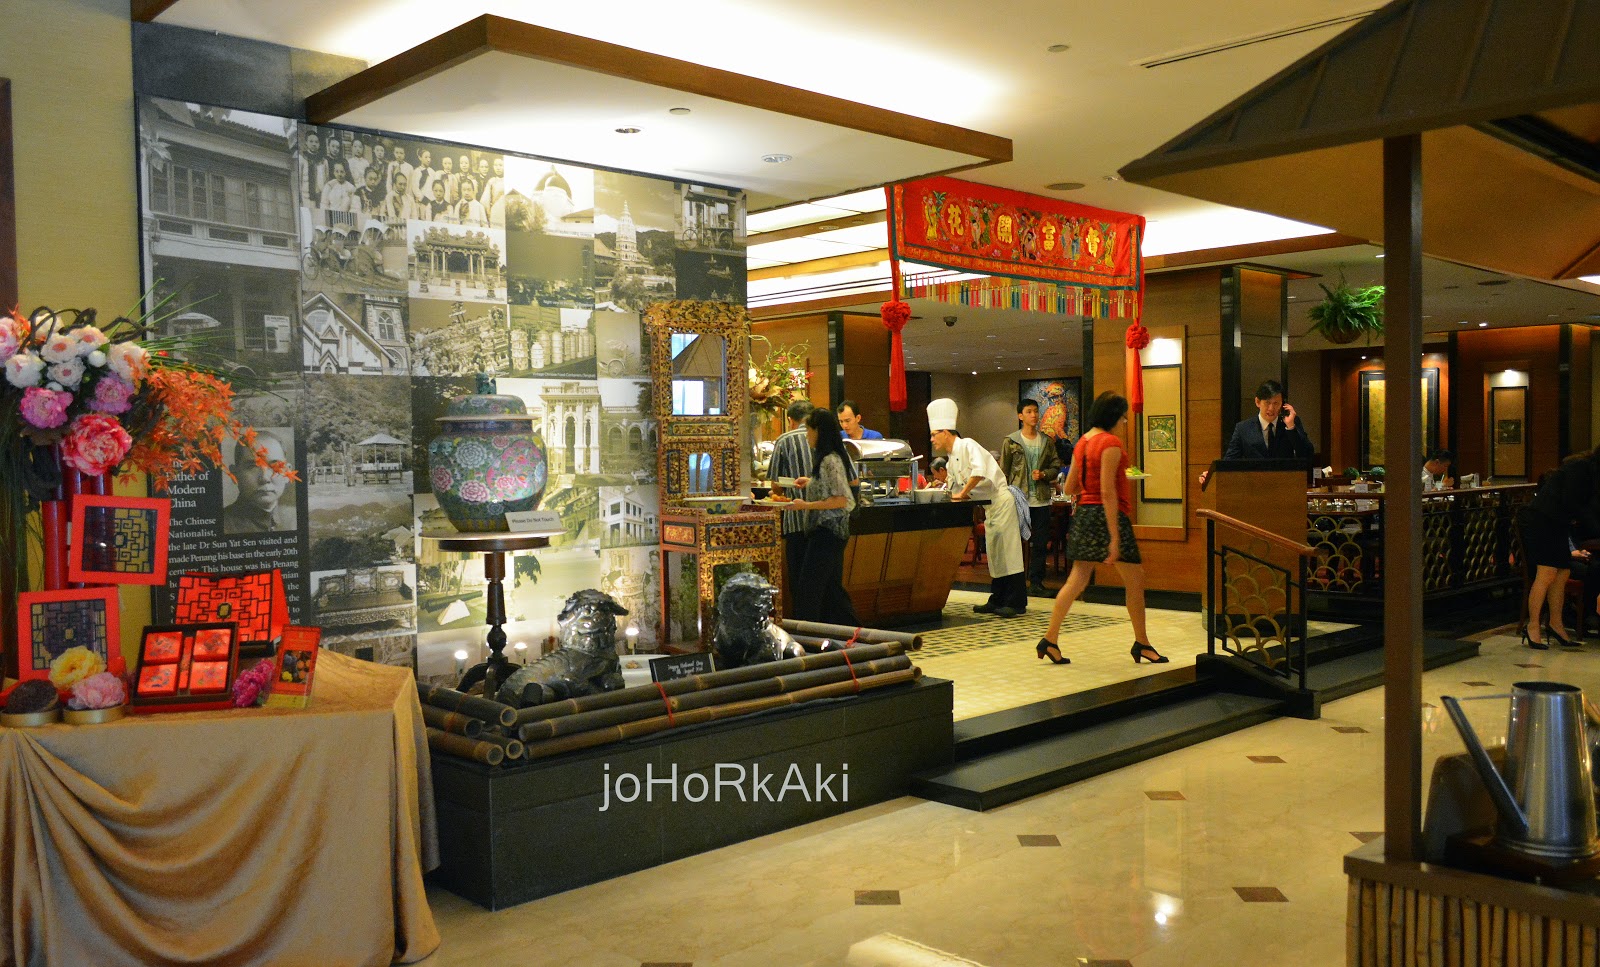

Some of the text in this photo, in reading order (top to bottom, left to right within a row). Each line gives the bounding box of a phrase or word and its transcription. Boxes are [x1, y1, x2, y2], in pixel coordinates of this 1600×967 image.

[199, 470, 210, 481] of
[167, 484, 206, 494] Modern
[185, 517, 216, 525] Chinese
[168, 529, 217, 539] Nationalist,
[168, 535, 298, 551] the late Dr Sun Yat Sen visited and
[168, 547, 298, 564] made Penang his base in the early 20th
[202, 564, 219, 573] This
[220, 563, 243, 573] house
[260, 561, 271, 569] his
[272, 560, 299, 569] Penang
[287, 582, 300, 590] the
[288, 593, 300, 602] the
